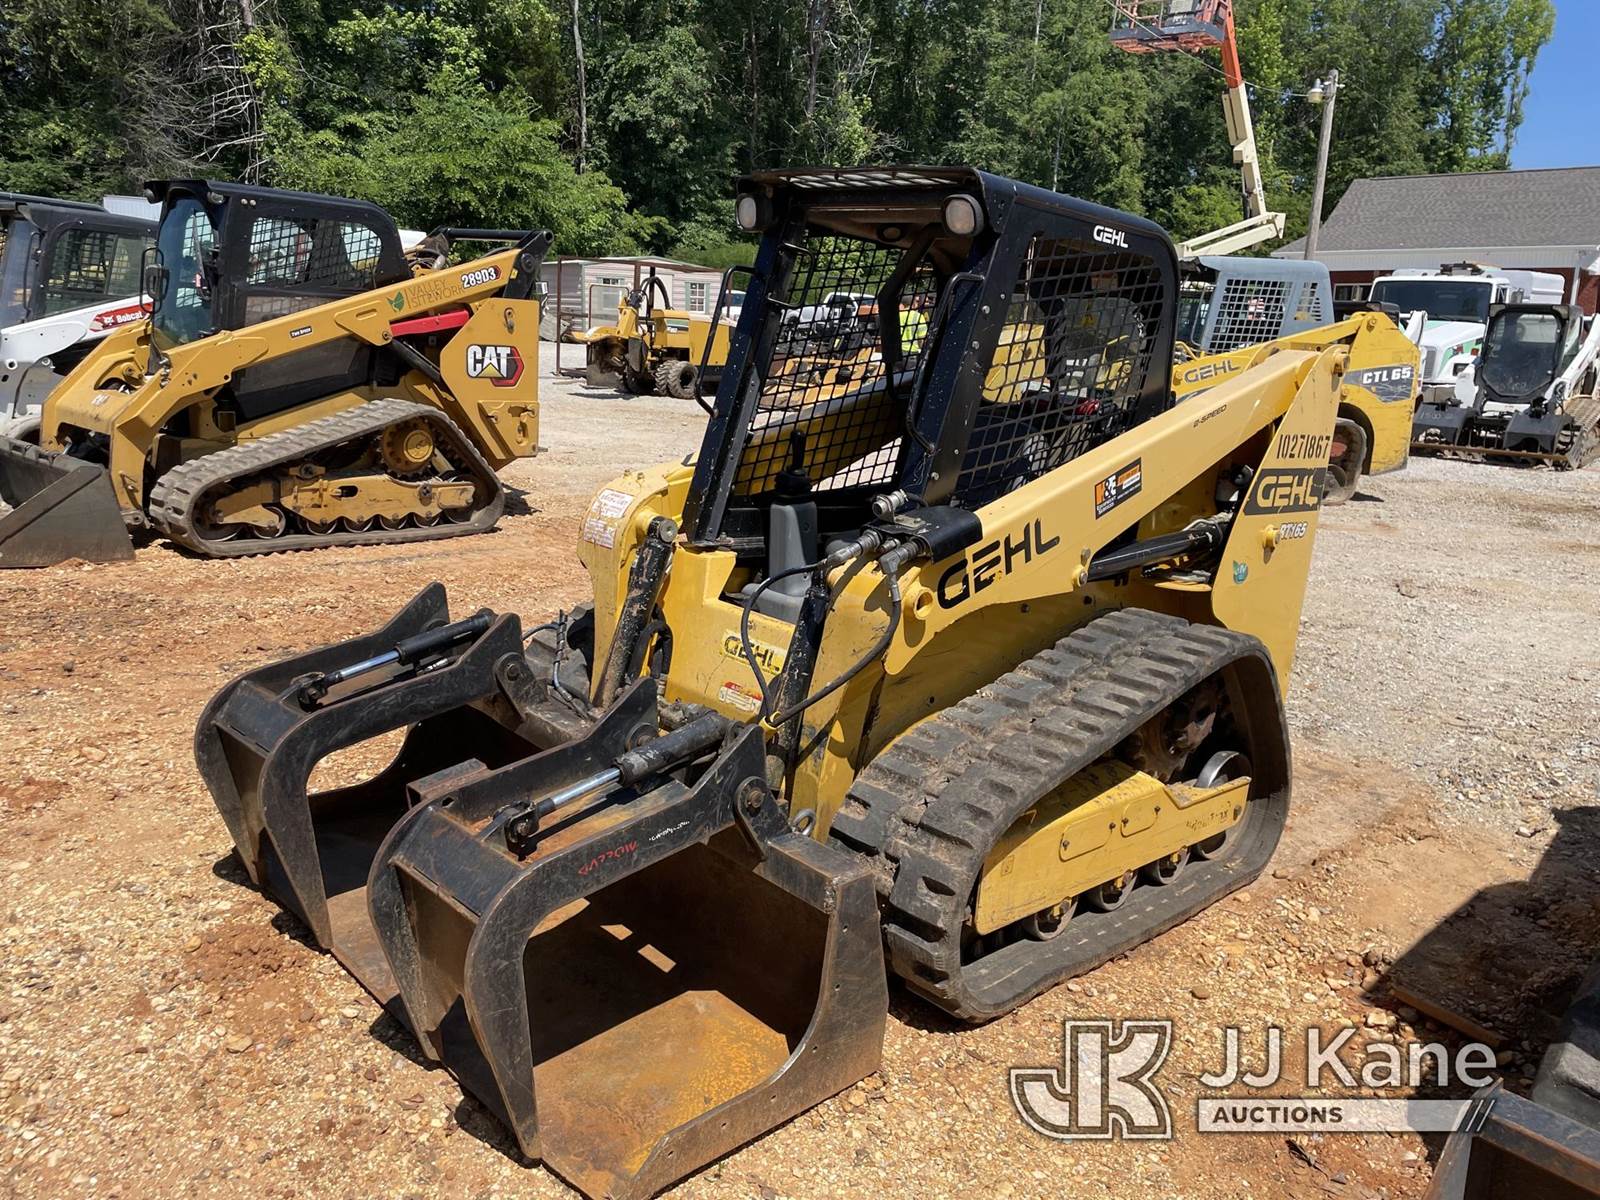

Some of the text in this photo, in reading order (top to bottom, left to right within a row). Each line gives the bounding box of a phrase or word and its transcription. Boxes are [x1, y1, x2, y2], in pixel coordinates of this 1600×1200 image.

[1093, 225, 1129, 248] GEHL
[407, 279, 447, 297] VALLEY
[461, 267, 496, 288] 289D3
[116, 310, 143, 323] Bobcat
[468, 345, 511, 378] CAT
[1184, 360, 1241, 383] GEHL
[1363, 367, 1411, 384] CTL 65
[1277, 434, 1330, 459] 10271867
[1257, 475, 1319, 508] GEHL
[937, 518, 1060, 609] GEHL
